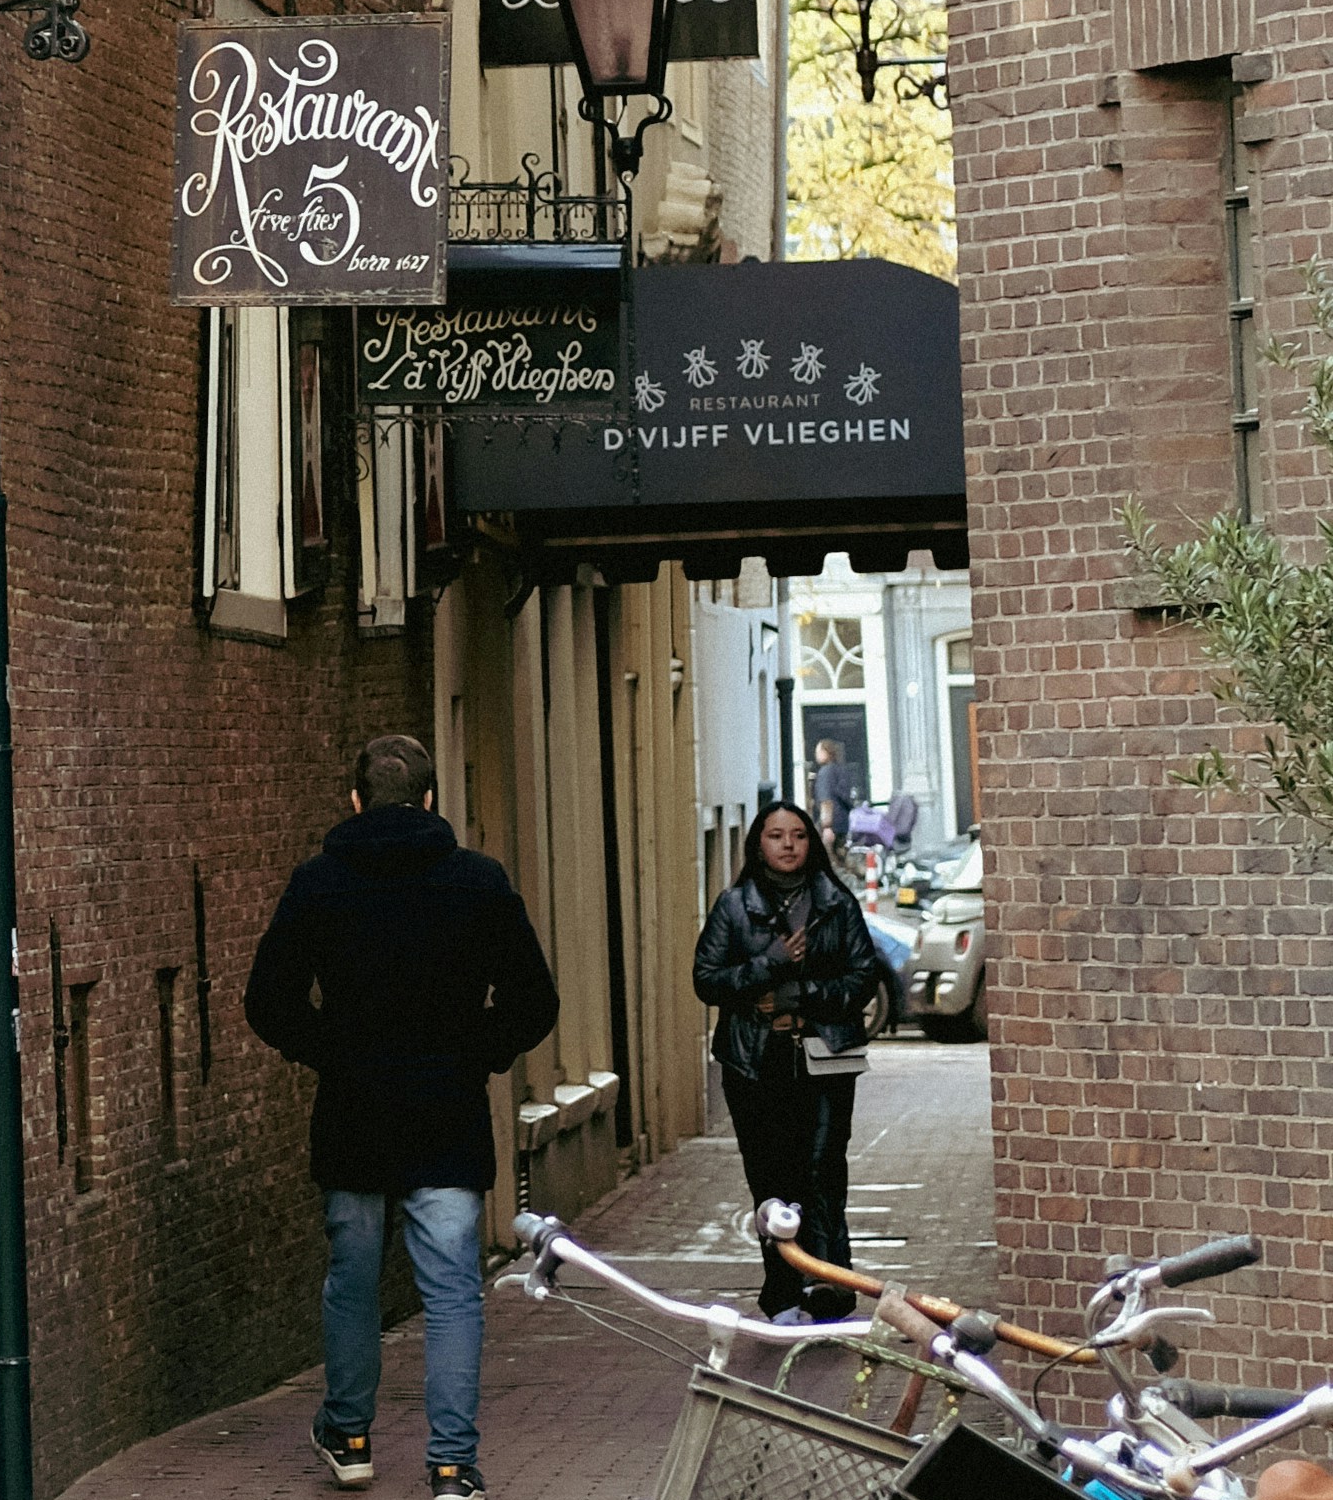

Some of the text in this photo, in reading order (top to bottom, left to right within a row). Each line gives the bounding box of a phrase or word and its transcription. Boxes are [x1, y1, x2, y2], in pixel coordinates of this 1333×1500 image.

[182, 39, 439, 287] Restaurant
[230, 188, 343, 244] five flies
[299, 155, 361, 266] 5
[346, 244, 430, 273] born 1627
[486, 332, 615, 404] Vlieghen
[689, 392, 821, 412] RESTAURANT
[603, 417, 911, 451] D'VIJFF VLIEGHEN
